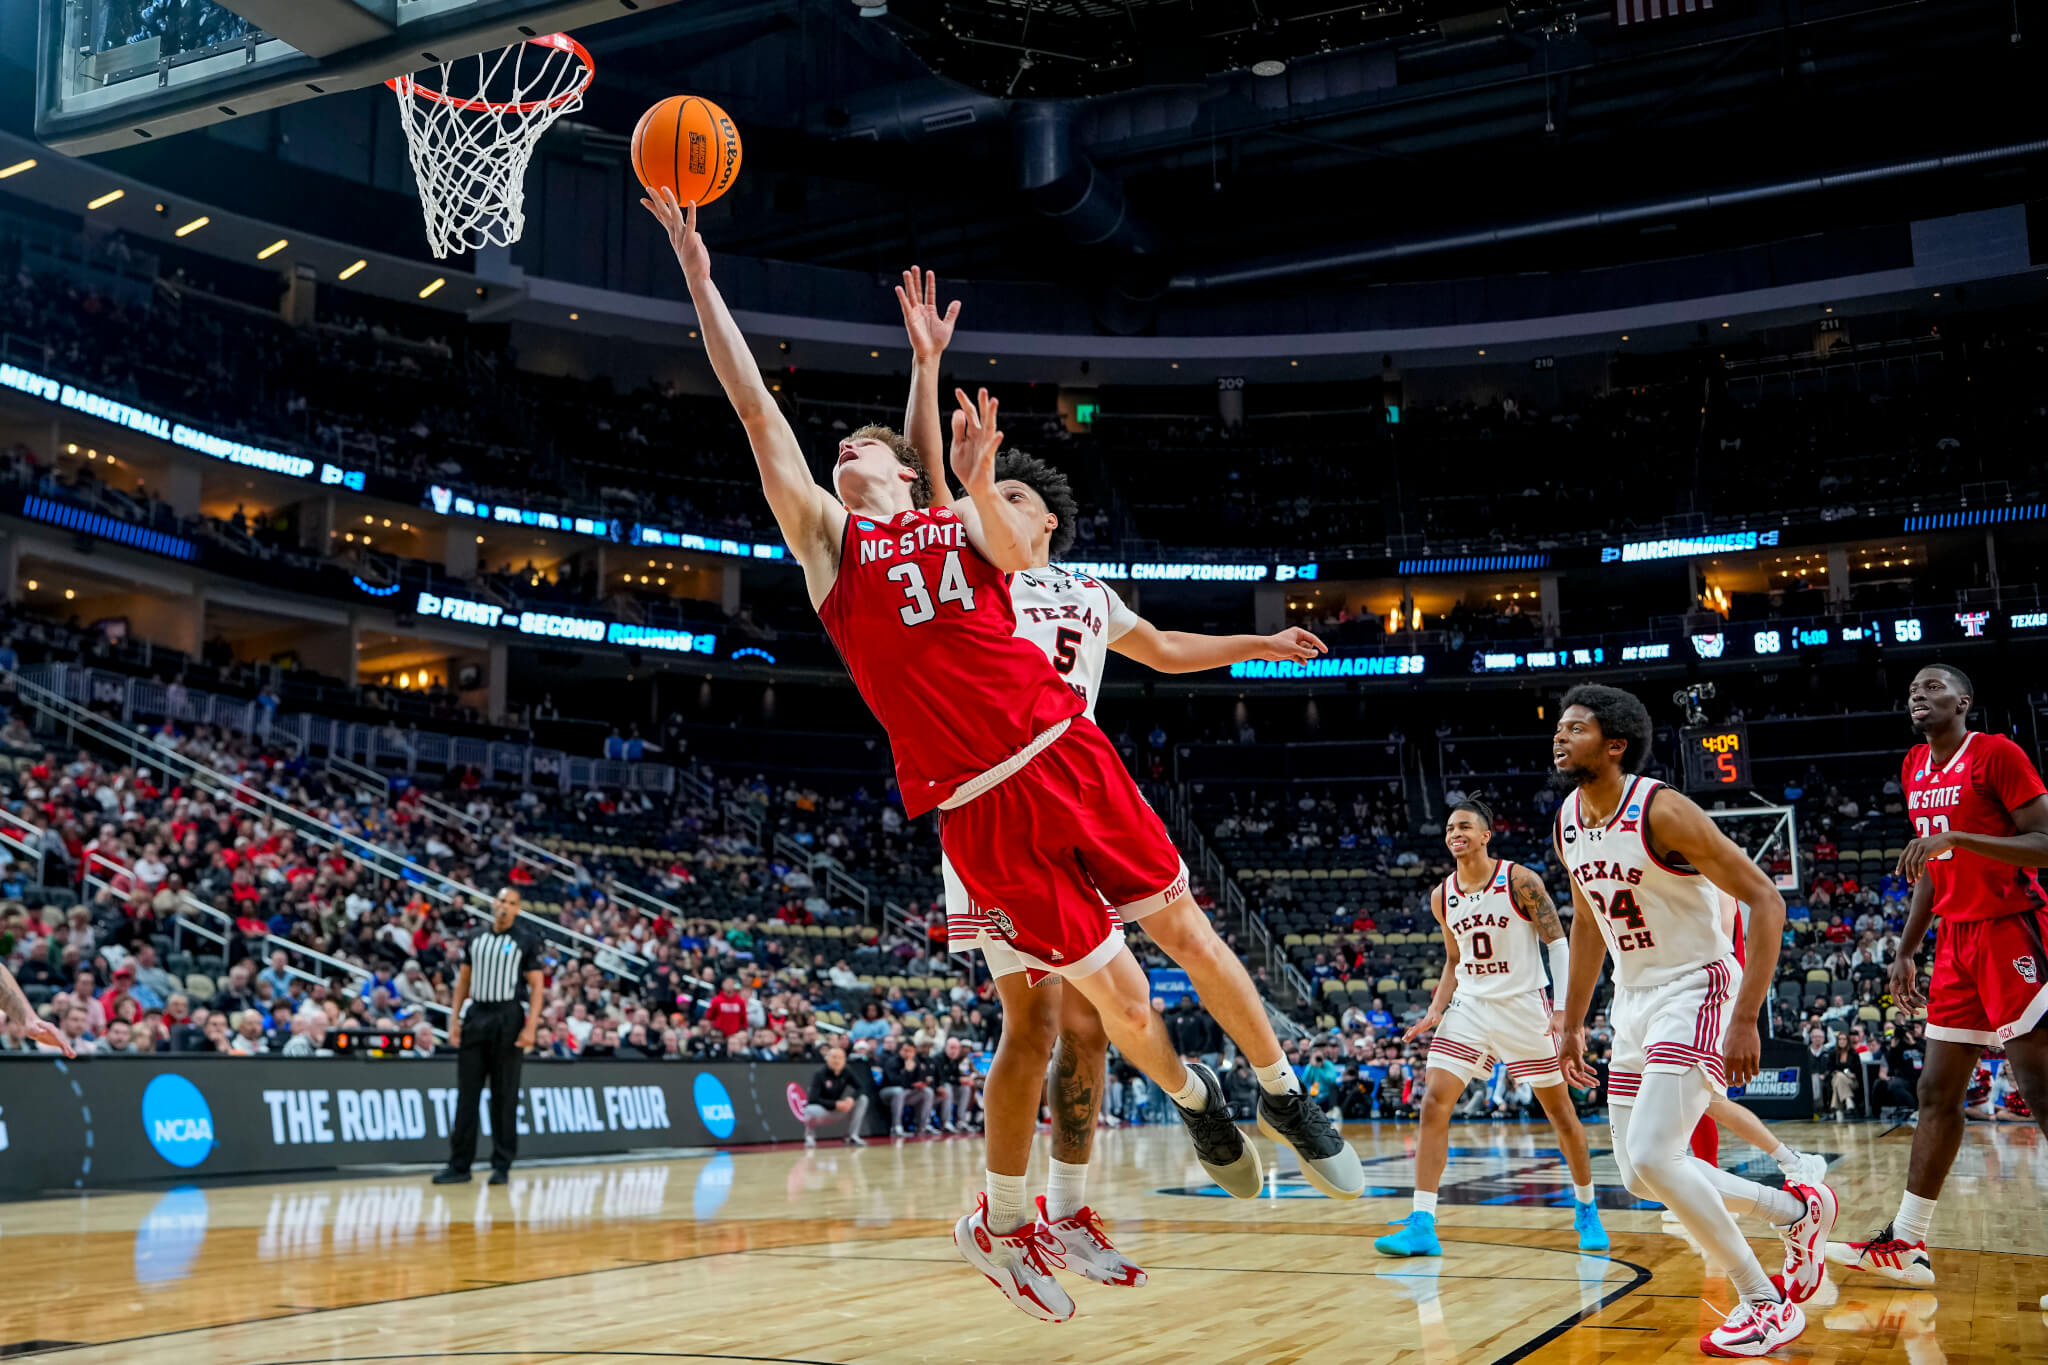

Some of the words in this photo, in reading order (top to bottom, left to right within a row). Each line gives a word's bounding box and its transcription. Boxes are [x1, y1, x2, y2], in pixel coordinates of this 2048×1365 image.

[717, 117, 738, 190] Wilson
[1820, 318, 1840, 331] 211
[1217, 377, 1245, 390] 209
[0, 363, 60, 401] MEN'S
[60, 385, 171, 440] BASKETBALL
[172, 424, 314, 477] CHAMPIONSHIP
[860, 539, 894, 566] NC
[899, 522, 967, 556] STATE
[1622, 532, 1757, 562] MARCHMADNESS
[1131, 563, 1267, 581] CHAMPIONSHIP
[886, 549, 977, 627] 34
[441, 595, 503, 627] FIRST
[519, 612, 606, 641] SECOND
[607, 622, 693, 652] ROUNDS
[1023, 605, 1102, 637] TEXAS
[1894, 619, 1922, 642] 56
[2010, 613, 2048, 628] TEXAS
[1754, 631, 1781, 654] 68
[1800, 629, 1828, 646] 4:09
[1842, 627, 1862, 641] 2nd
[1053, 626, 1082, 676] 5
[1559, 651, 1568, 665] 7
[1622, 647, 1638, 660] NC
[1638, 644, 1669, 659] STATE
[1231, 655, 1425, 678] #MARCHMADNESS
[1702, 734, 1739, 753] 4:09
[1717, 753, 1737, 782] 5
[1908, 791, 1923, 809] NC
[1921, 785, 1962, 809] STATE
[1573, 861, 1643, 886] TEXAS
[1163, 872, 1187, 904] PACK
[1452, 914, 1510, 935] TEXAS
[1472, 932, 1493, 960] 0
[1465, 961, 1510, 975] TECH
[1745, 1082, 1797, 1096] MADNESS
[262, 1089, 335, 1145] THE
[337, 1087, 427, 1142] ROAD
[529, 1085, 605, 1135] FINAL
[602, 1084, 671, 1131] FOUR
[702, 1103, 735, 1121] NCAA
[154, 1117, 214, 1143] NCAA
